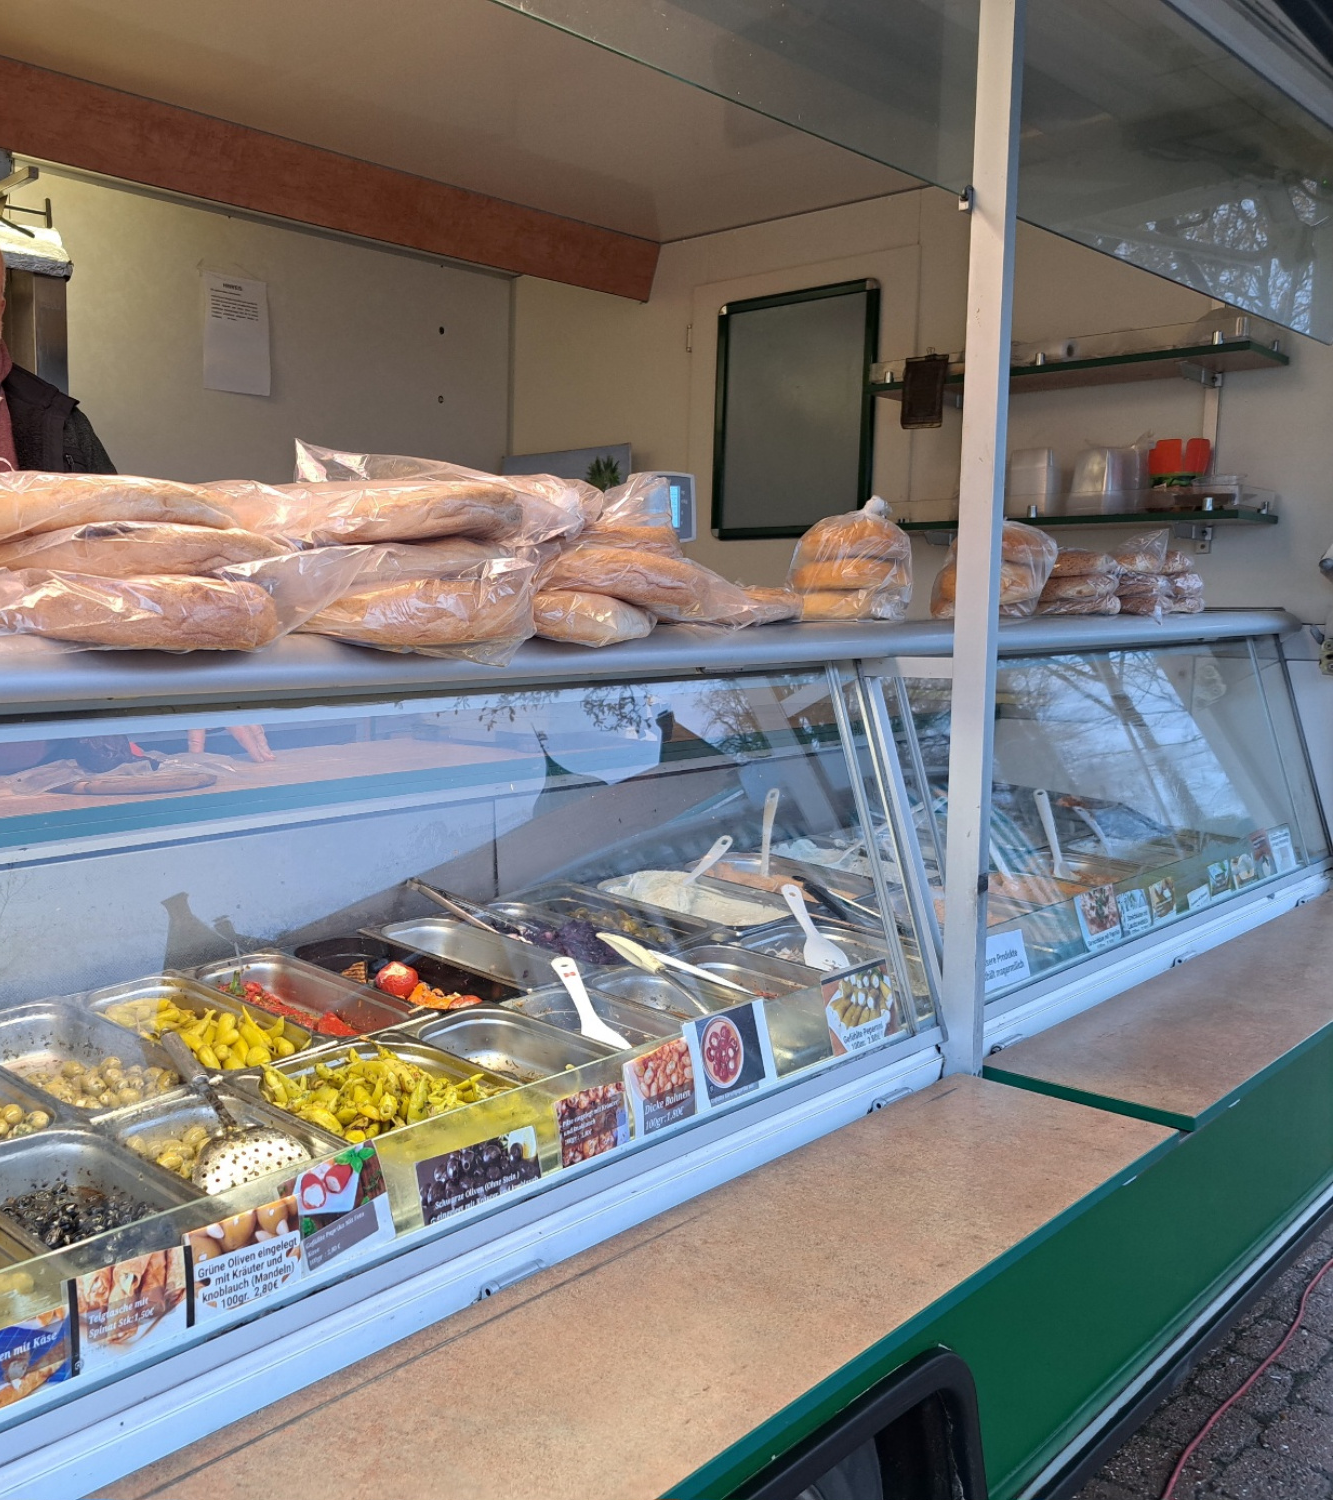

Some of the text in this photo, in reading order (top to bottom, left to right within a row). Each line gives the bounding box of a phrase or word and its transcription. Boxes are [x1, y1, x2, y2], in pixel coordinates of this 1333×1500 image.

[644, 1091, 691, 1116] Dicke Bohnen
[197, 1236, 298, 1278] Grüne Oliven eingelegt
[215, 1254, 283, 1286] mit Kräuter und
[202, 1261, 295, 1303] knoblauch (Mandeln)
[221, 1281, 279, 1311] 100gr. 2,80€
[88, 1296, 149, 1326] Teigtasche mit
[13, 1341, 31, 1356] mit
[32, 1331, 58, 1350] Käse
[88, 1320, 117, 1341] Spinat
